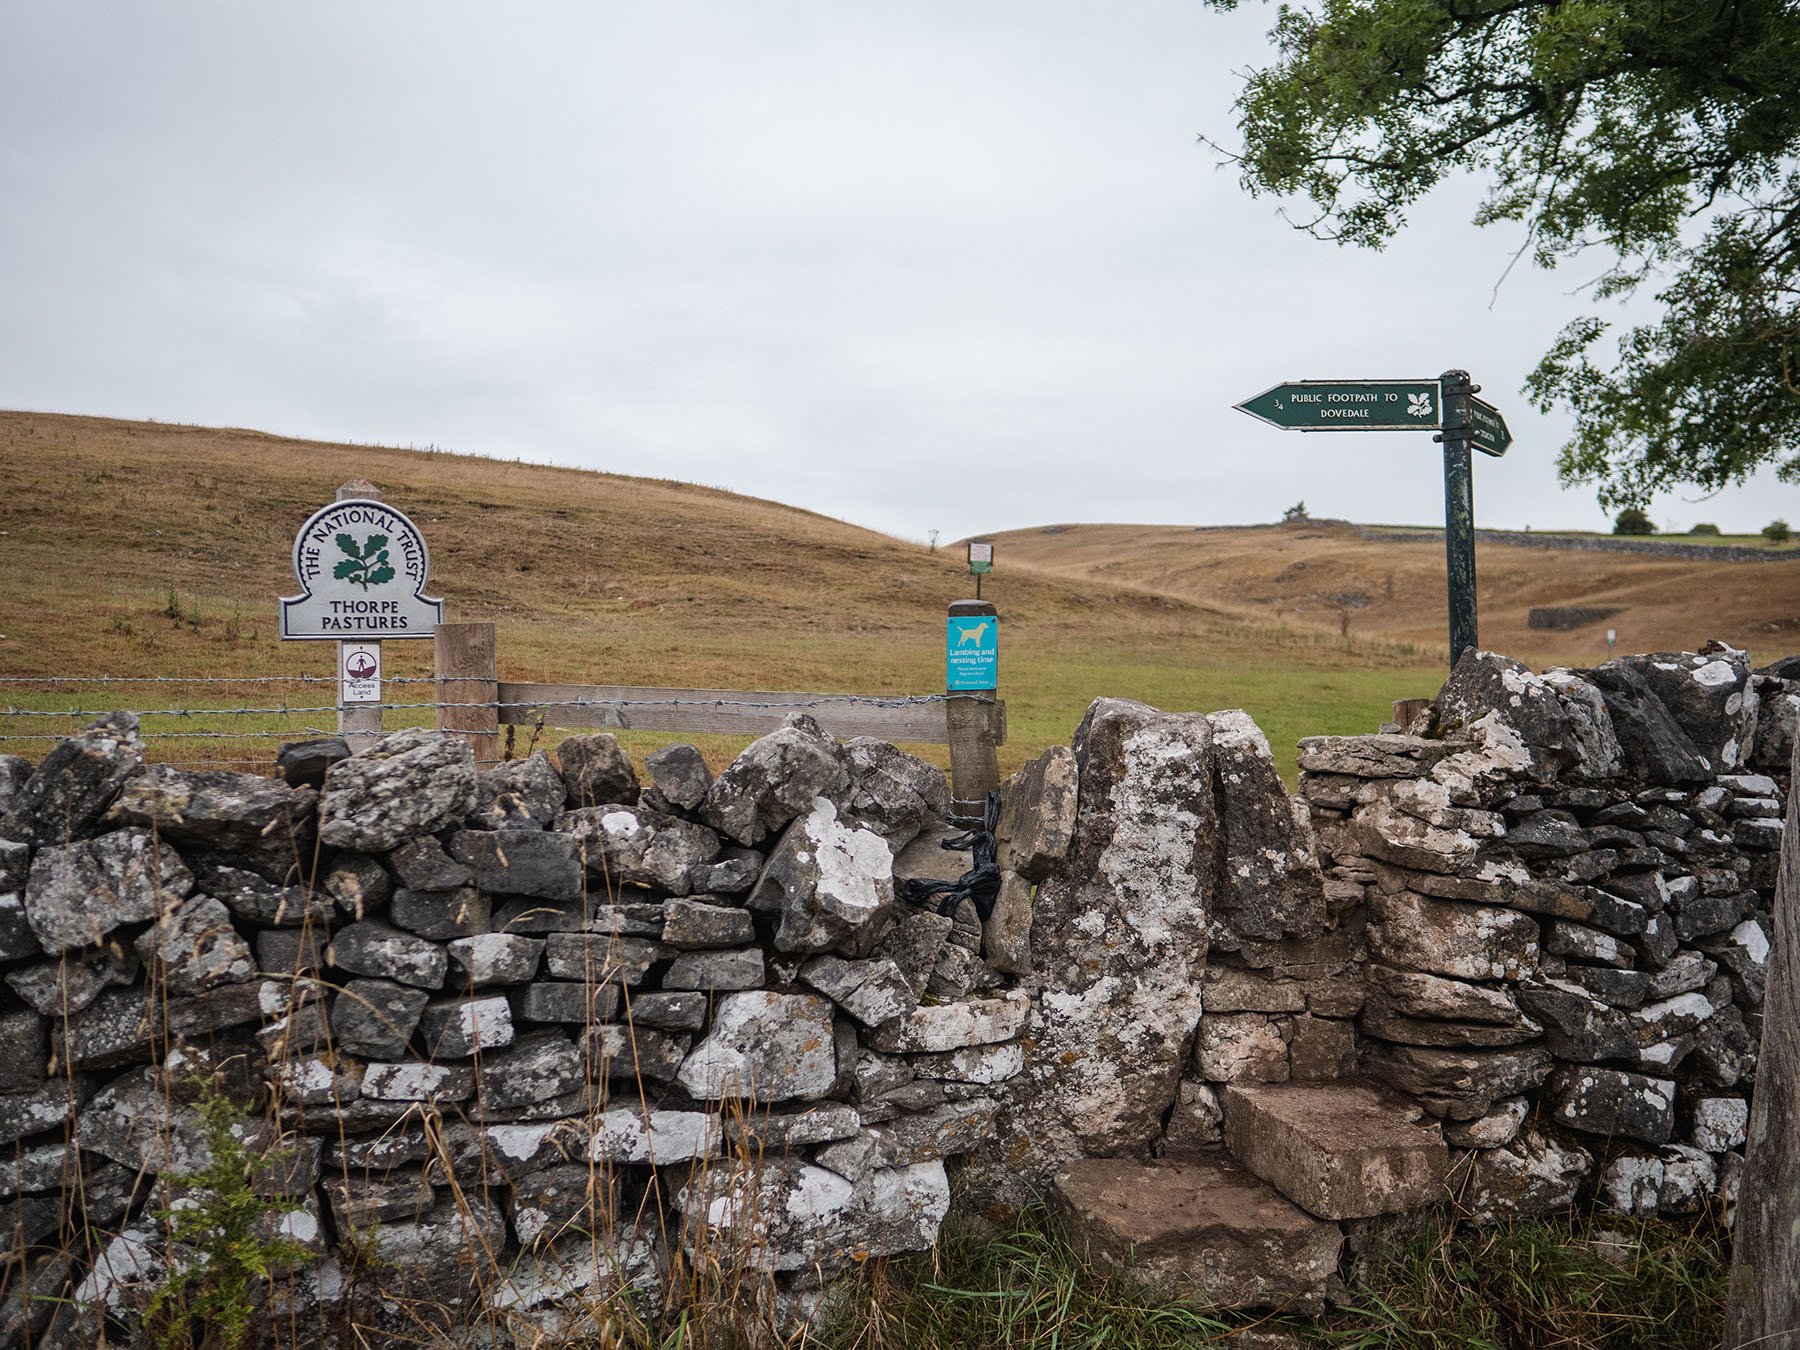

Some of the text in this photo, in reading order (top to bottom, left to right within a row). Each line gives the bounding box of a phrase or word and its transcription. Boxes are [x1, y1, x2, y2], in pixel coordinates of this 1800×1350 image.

[1291, 393, 1398, 403] PUBLIC FOOTPATH TO
[1320, 409, 1369, 418] DOVEDALE
[305, 510, 419, 581] THE NATIONAL TRUST
[329, 600, 398, 613] THORPE
[322, 616, 408, 629] PASTURES
[949, 648, 980, 657] Lambing
[950, 656, 977, 665] nesting
